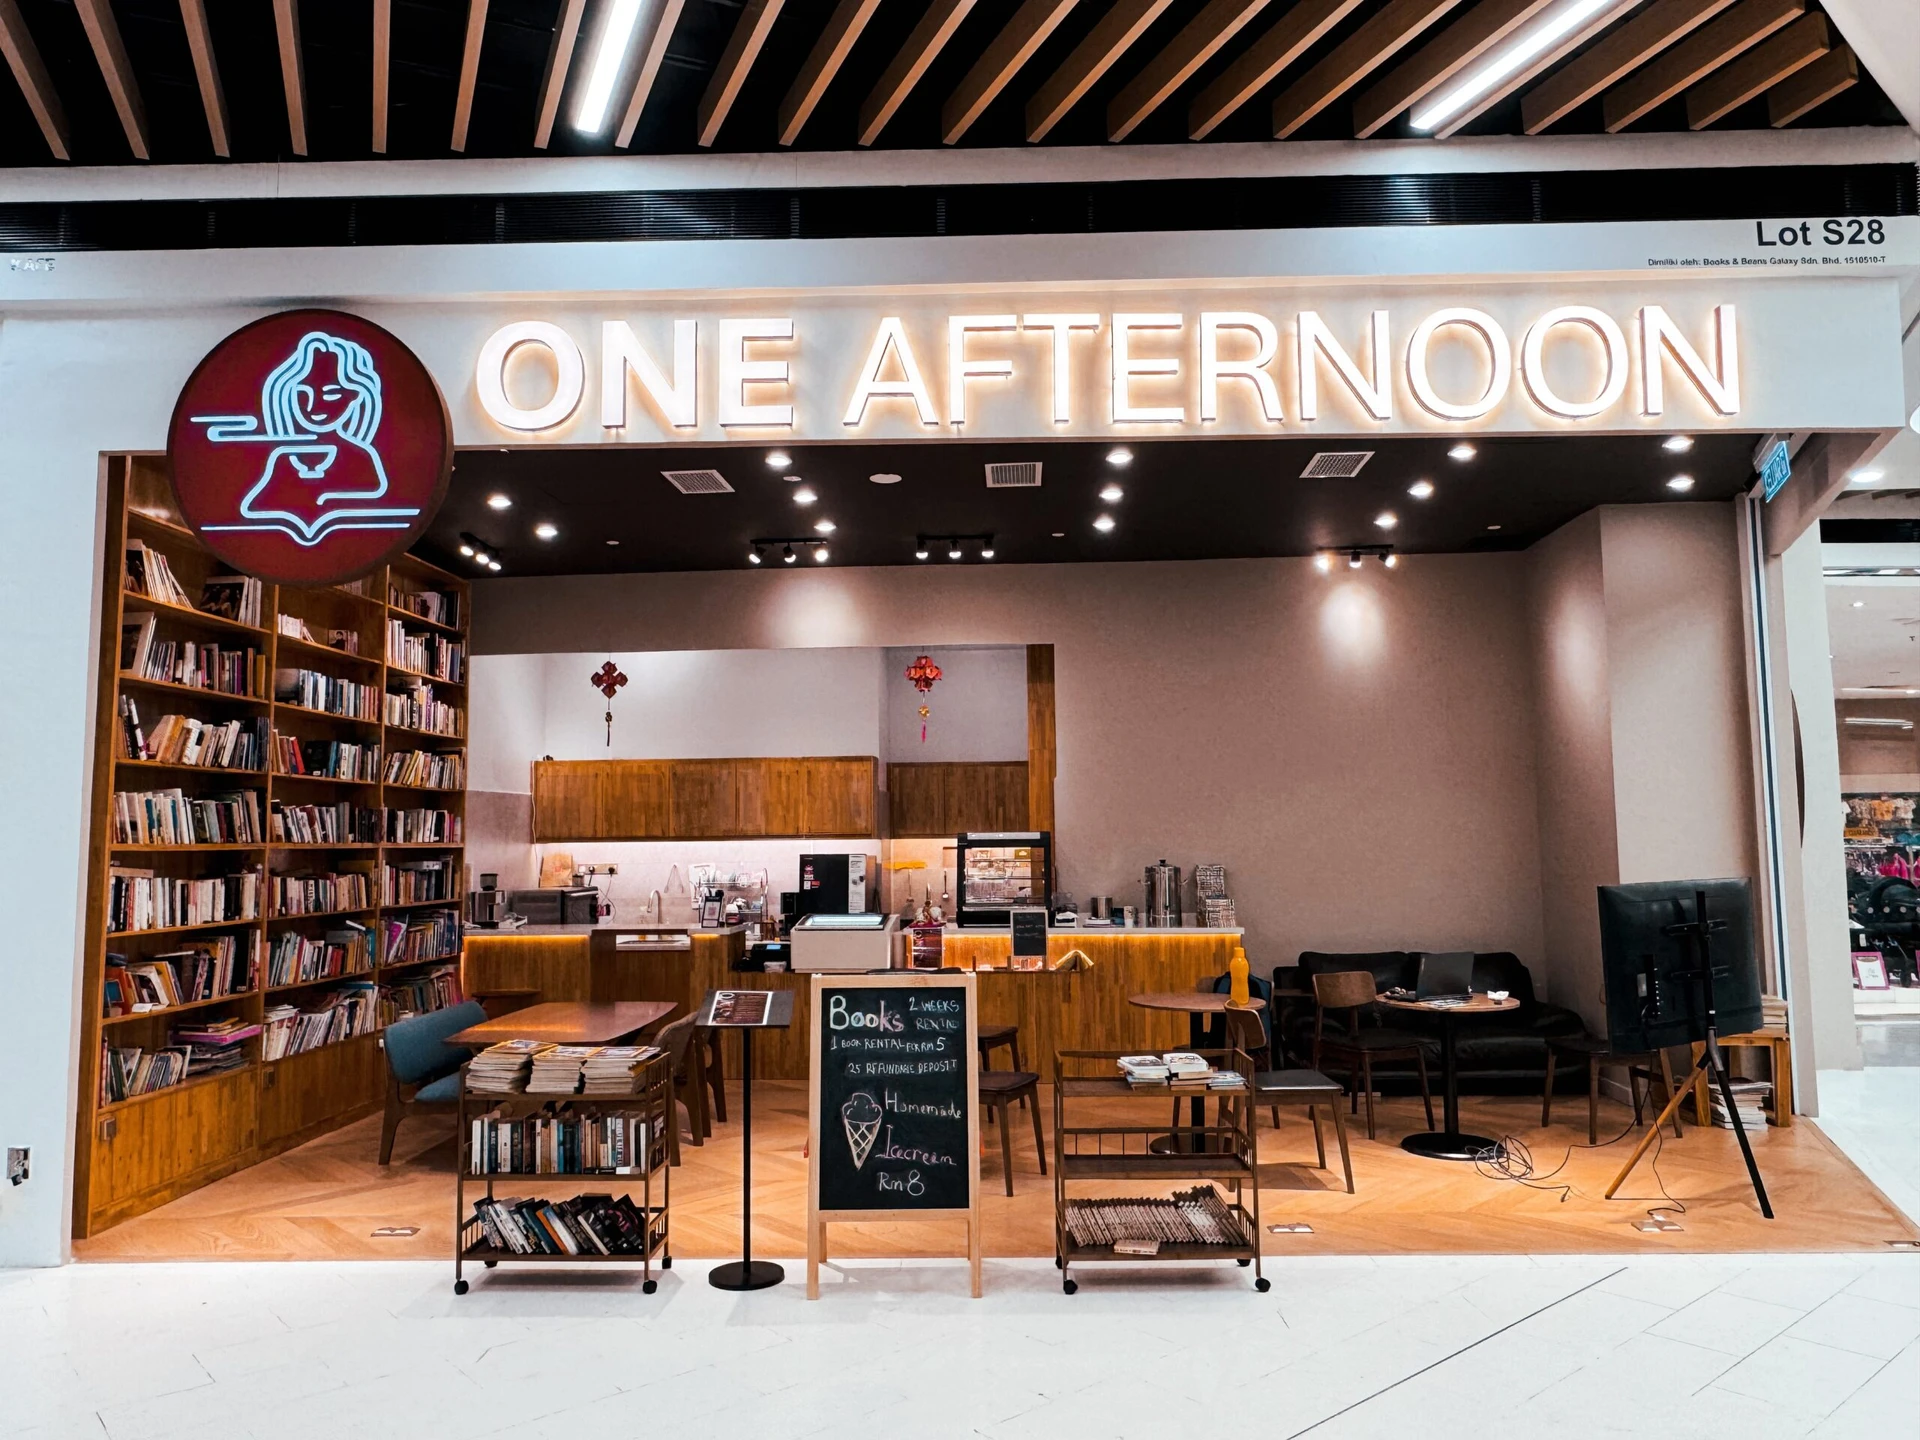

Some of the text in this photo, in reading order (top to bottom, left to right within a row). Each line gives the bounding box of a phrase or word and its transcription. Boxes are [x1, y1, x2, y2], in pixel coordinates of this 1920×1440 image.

[1756, 218, 1885, 246] Lot S28
[1648, 258, 1679, 267] Dimiliki
[1680, 258, 1701, 266] oleh:
[1703, 257, 1731, 266] Books
[1732, 257, 1740, 265] &
[1741, 256, 1768, 265] Beans
[1769, 256, 1799, 267] Galaxy
[1822, 256, 1842, 265] Bhd.
[475, 303, 1741, 433] ONE AFTERNOON
[829, 995, 905, 1032] Books
[908, 996, 960, 1013] 2 WEEKS
[830, 1035, 838, 1051] 1
[864, 1038, 906, 1051] RENTAL
[935, 1037, 946, 1051] 5
[848, 1063, 861, 1075] 25
[885, 1087, 962, 1119] Homemade
[907, 1169, 926, 1197] 8
